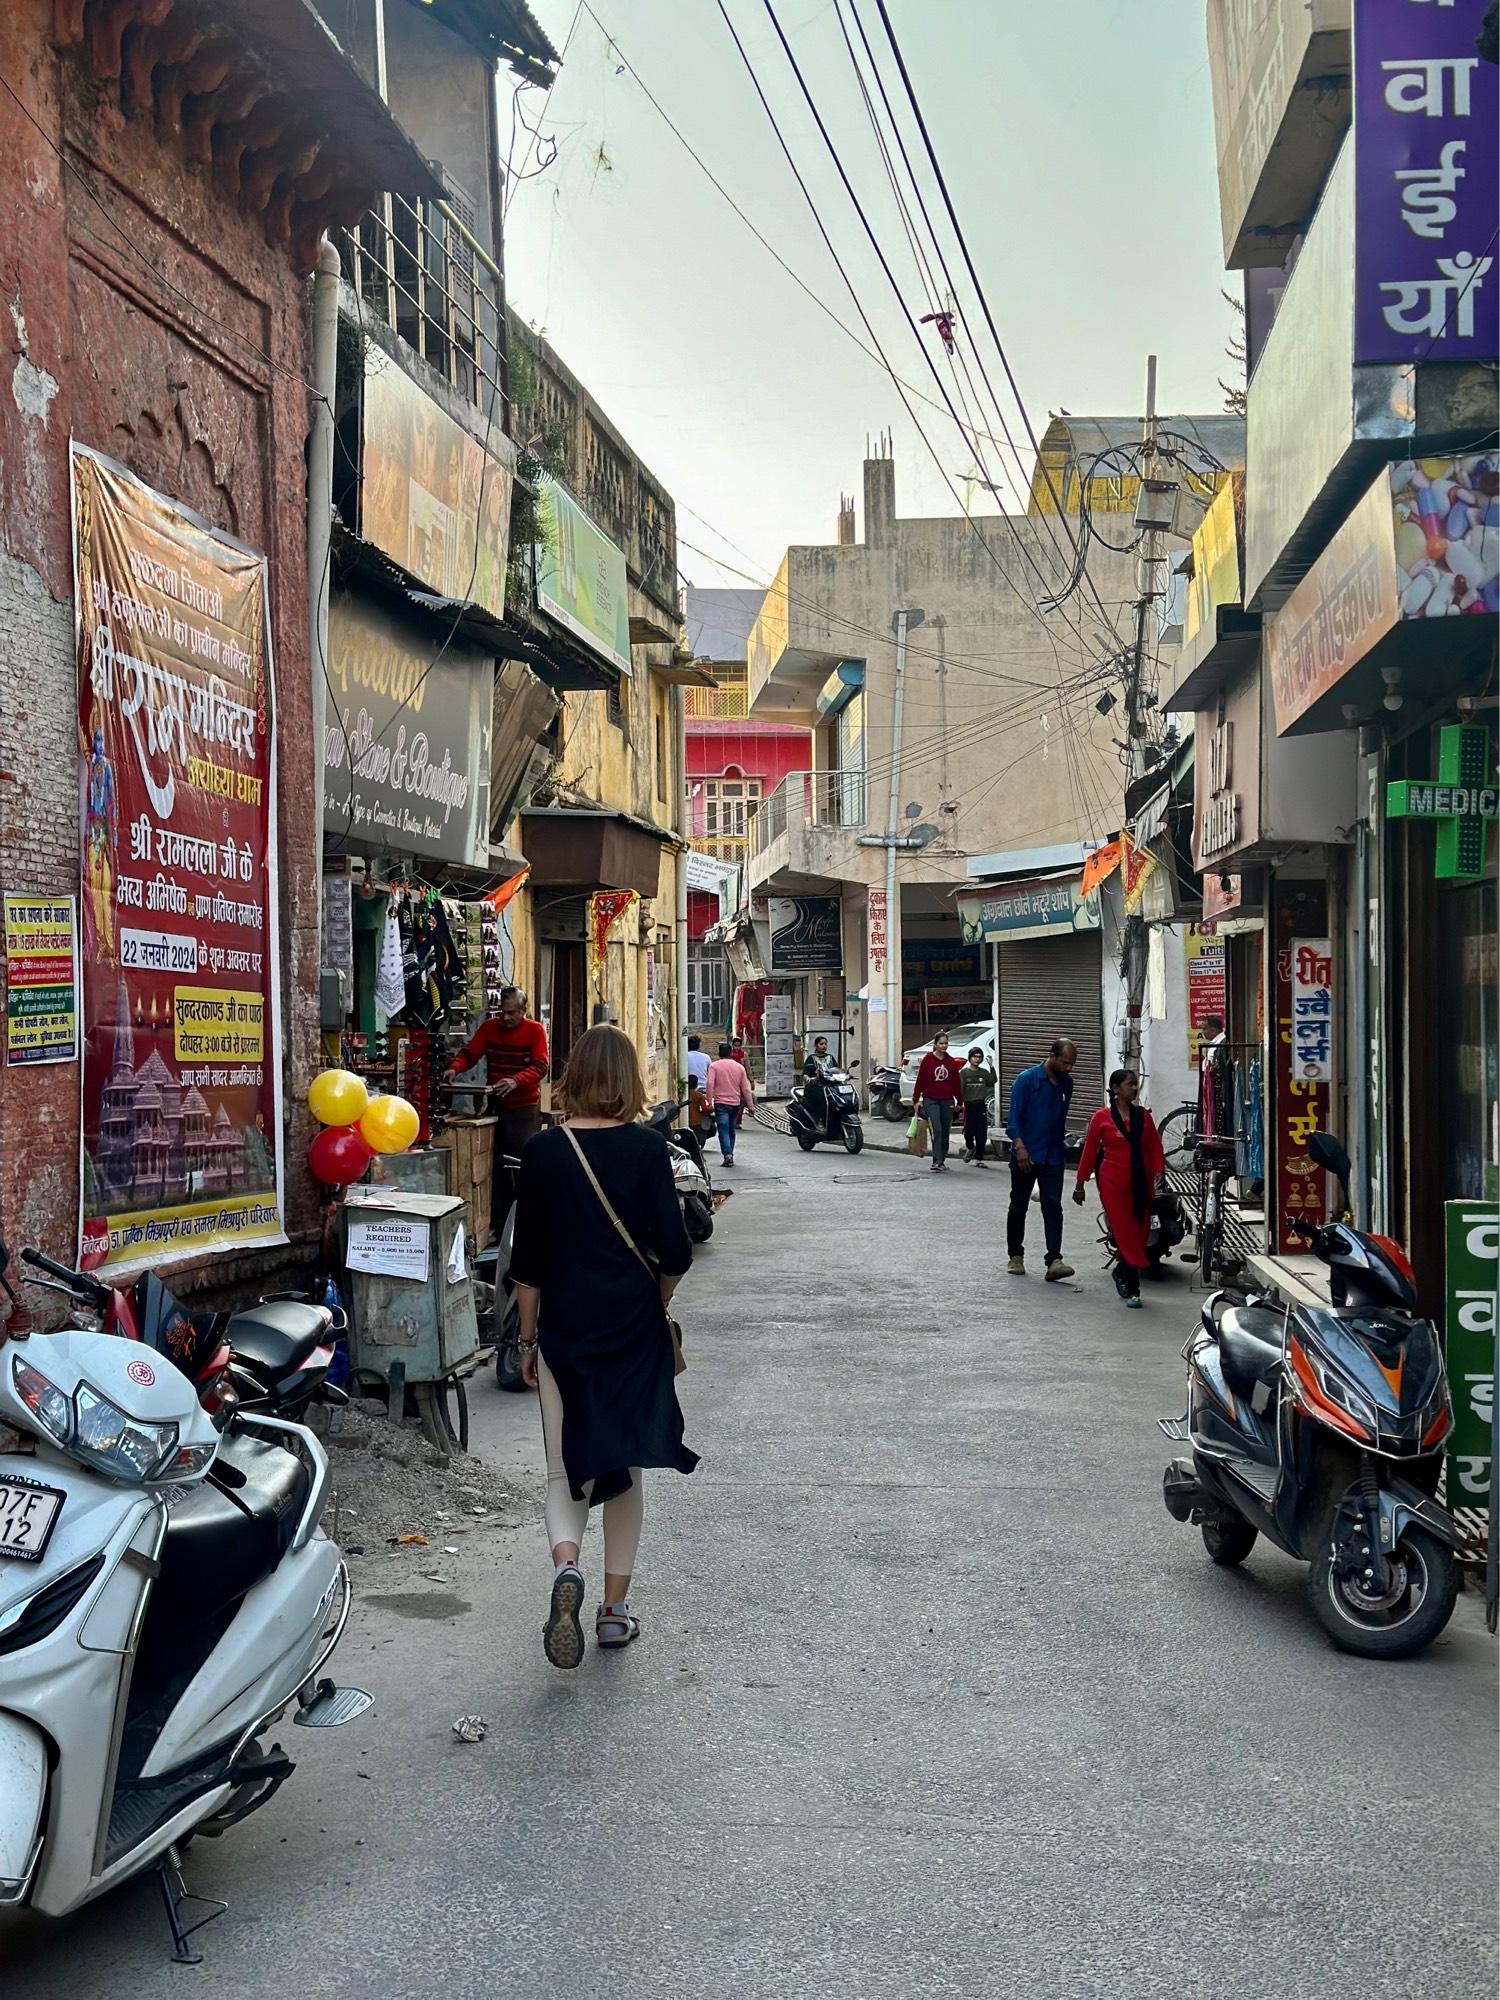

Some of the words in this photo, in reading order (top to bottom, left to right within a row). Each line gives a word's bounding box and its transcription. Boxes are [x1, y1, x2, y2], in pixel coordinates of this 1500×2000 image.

[1379, 0, 1494, 338] वाईयाँ
[156, 606, 171, 639] जी
[173, 618, 188, 647] का
[190, 626, 219, 663] प्राचीन
[90, 624, 114, 701] श्री
[116, 651, 188, 820] राम
[189, 674, 257, 760] मन्दिर
[390, 725, 408, 790] &
[405, 732, 468, 823] Boutique
[1410, 786, 1499, 816] MEDIC
[130, 813, 152, 861] श्री
[156, 828, 217, 875] रामलला
[220, 836, 237, 880] जी
[240, 841, 253, 882] के
[117, 874, 143, 908] भव्य
[146, 872, 187, 915] अभिषेक
[195, 894, 211, 920] प्राण
[212, 891, 236, 924] प्रतिष्ठा
[237, 899, 263, 930] समारोह
[870, 892, 887, 906] दुकान
[870, 906, 887, 920] किराए
[982, 900, 1013, 923] अग्रवाल
[1013, 890, 1030, 917] छोले
[1032, 888, 1051, 923] भटूरे
[1052, 885, 1070, 912] शॉप
[871, 932, 886, 945] लिए
[874, 921, 881, 931] के
[123, 939, 137, 964] 22
[140, 936, 169, 967] जनवरी
[171, 945, 196, 970] 2024
[198, 940, 208, 966] के
[209, 946, 225, 974] शुभ
[226, 949, 250, 972] अवसर
[252, 953, 263, 973] पर
[176, 998, 224, 1025] सुन्दरकाण्ड
[226, 996, 236, 1022] जी
[238, 1003, 248, 1022] का
[249, 1004, 262, 1024] पाठ
[179, 1030, 204, 1053] दोपहर
[221, 1031, 232, 1053] बजे
[233, 1032, 240, 1054] से
[181, 1069, 194, 1087] आप
[195, 1065, 210, 1087] सभी
[211, 1069, 228, 1087] सादर
[122, 1221, 145, 1249] प्रतीक
[145, 1216, 179, 1244] मिश्रपुरी
[194, 1215, 218, 1235] समस्त
[218, 1206, 248, 1232] मिश्रपुरी
[250, 1204, 277, 1225] परिवार
[366, 1225, 412, 1234] TEACHERS
[366, 1234, 412, 1243] REQUIRED
